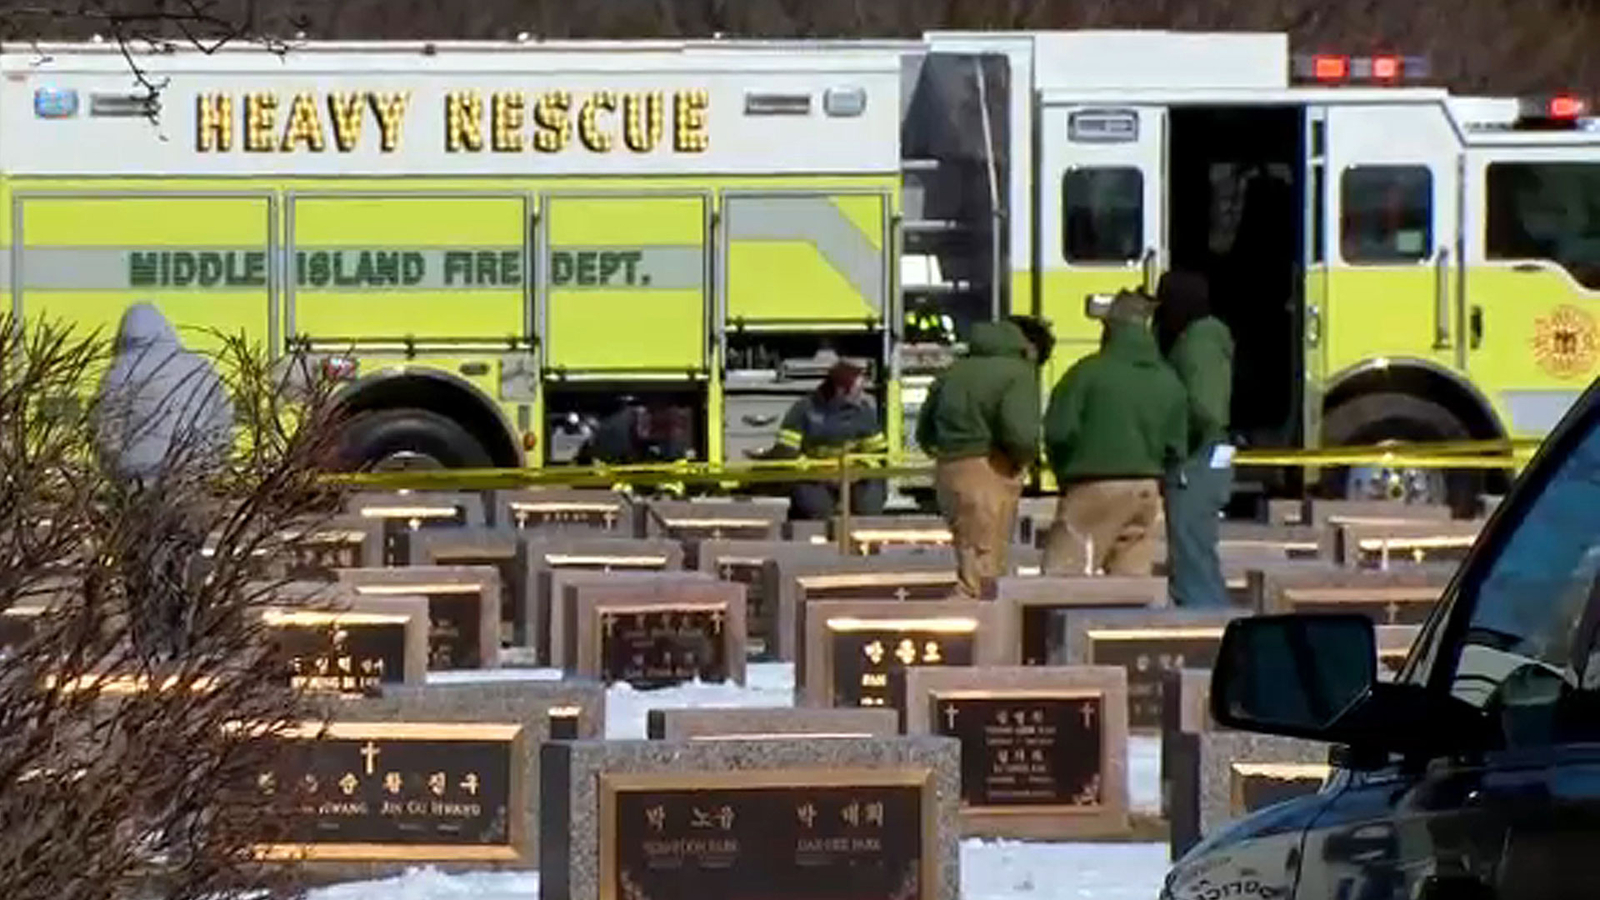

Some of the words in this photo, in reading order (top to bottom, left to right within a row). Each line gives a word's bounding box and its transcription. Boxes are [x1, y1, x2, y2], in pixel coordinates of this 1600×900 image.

[195, 89, 411, 153] HEAVY
[445, 89, 710, 153] RESCUE
[130, 252, 265, 286] MIDDLE
[296, 251, 425, 286] ISLAND
[443, 251, 521, 285] FIRE
[552, 251, 651, 286] DEPT.
